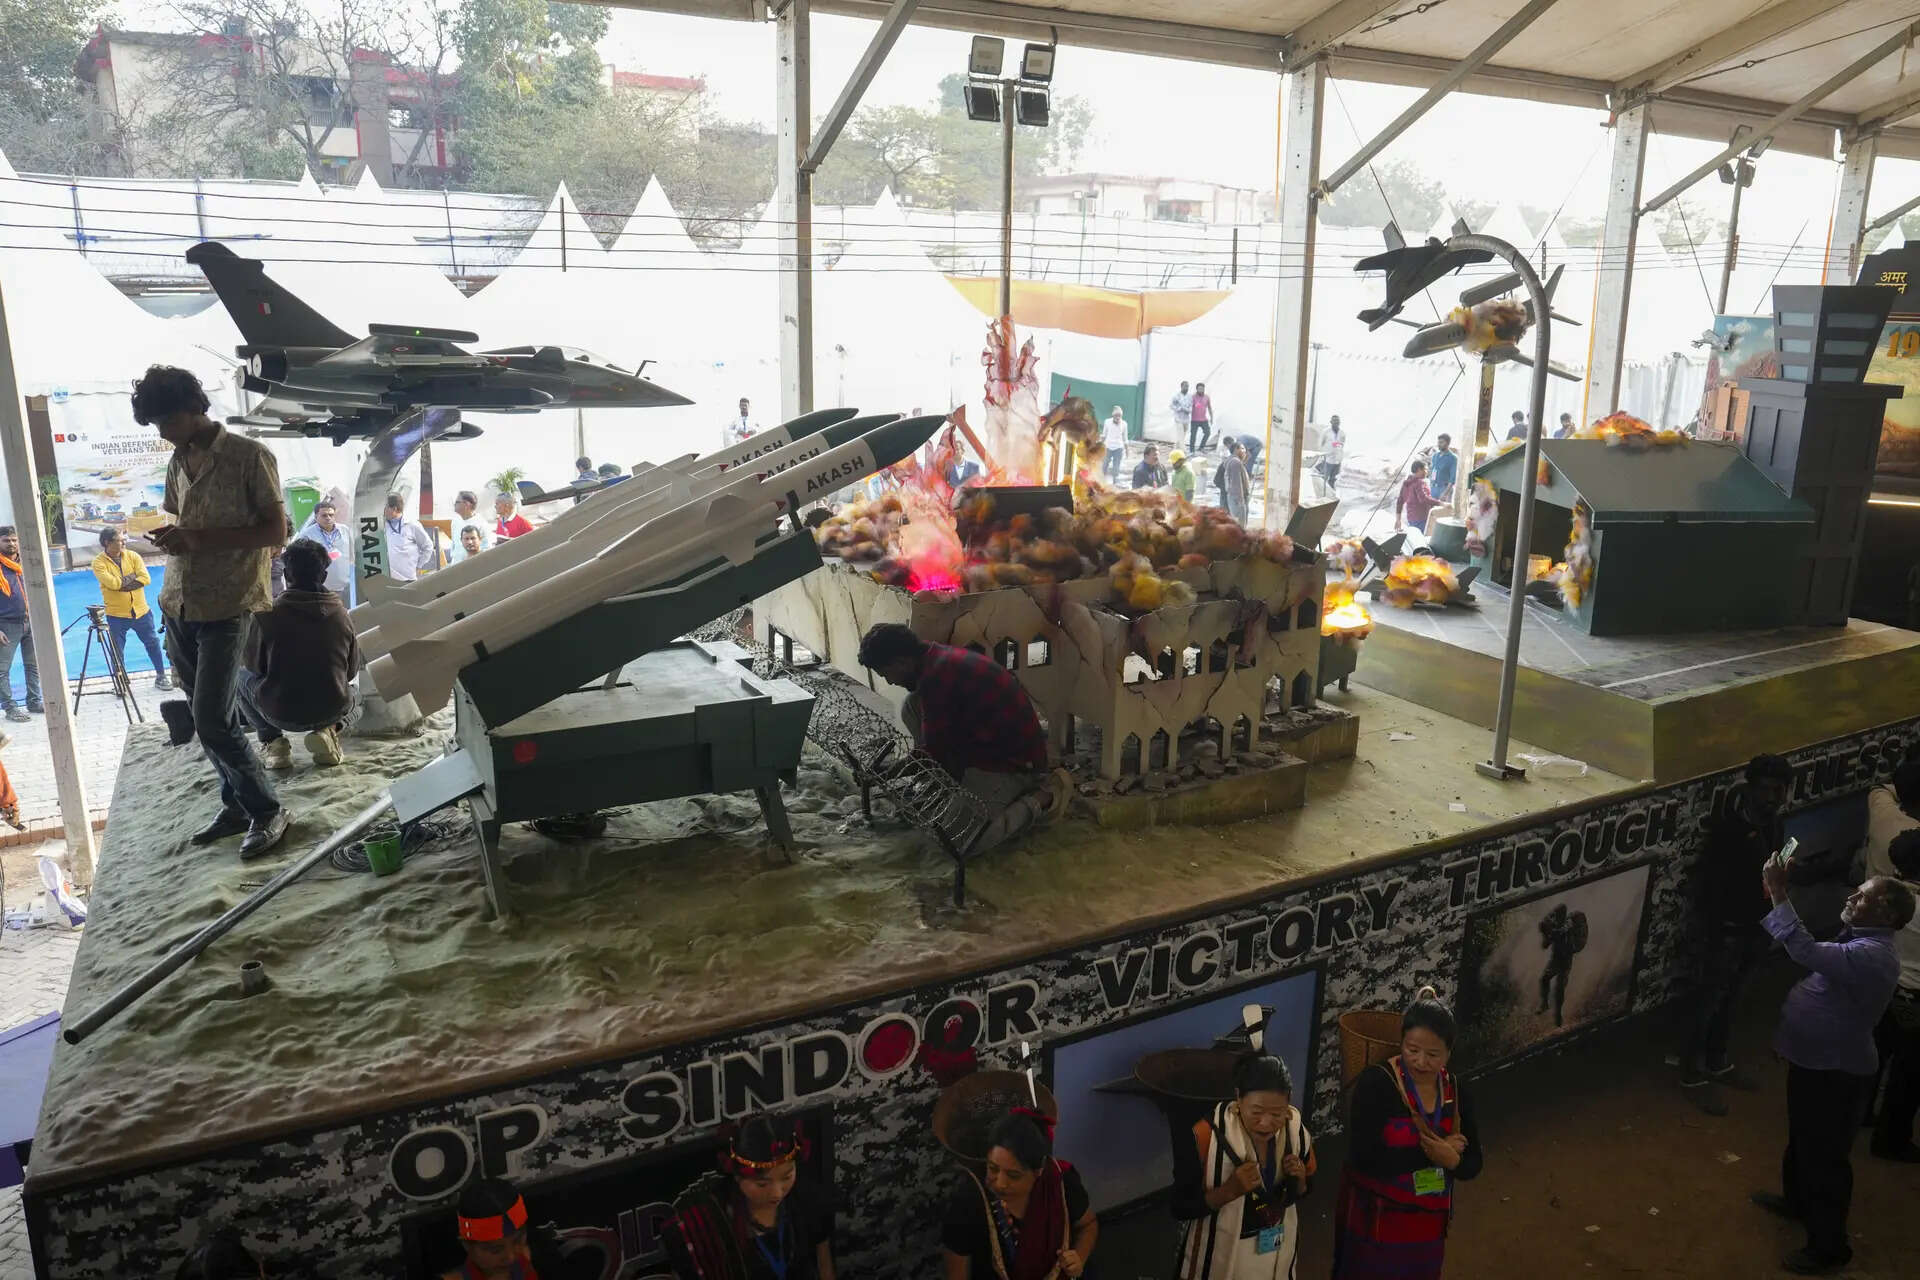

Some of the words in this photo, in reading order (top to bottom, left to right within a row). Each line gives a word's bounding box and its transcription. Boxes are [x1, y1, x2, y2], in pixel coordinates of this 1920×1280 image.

[1880, 271, 1908, 283] अमर
[91, 442, 119, 450] INDIAN
[121, 440, 157, 448] DEFENCE
[102, 447, 144, 455] VETERANS
[732, 440, 784, 468] AKASH
[767, 447, 820, 478] AKASH
[807, 455, 865, 493] AKASH
[389, 1103, 550, 1200] OP
[620, 979, 1043, 1142] SINDOOR
[1094, 879, 1403, 1012] VICTORY
[1443, 800, 1681, 911] THROUGH
[1698, 734, 1905, 826] JOTNESS
